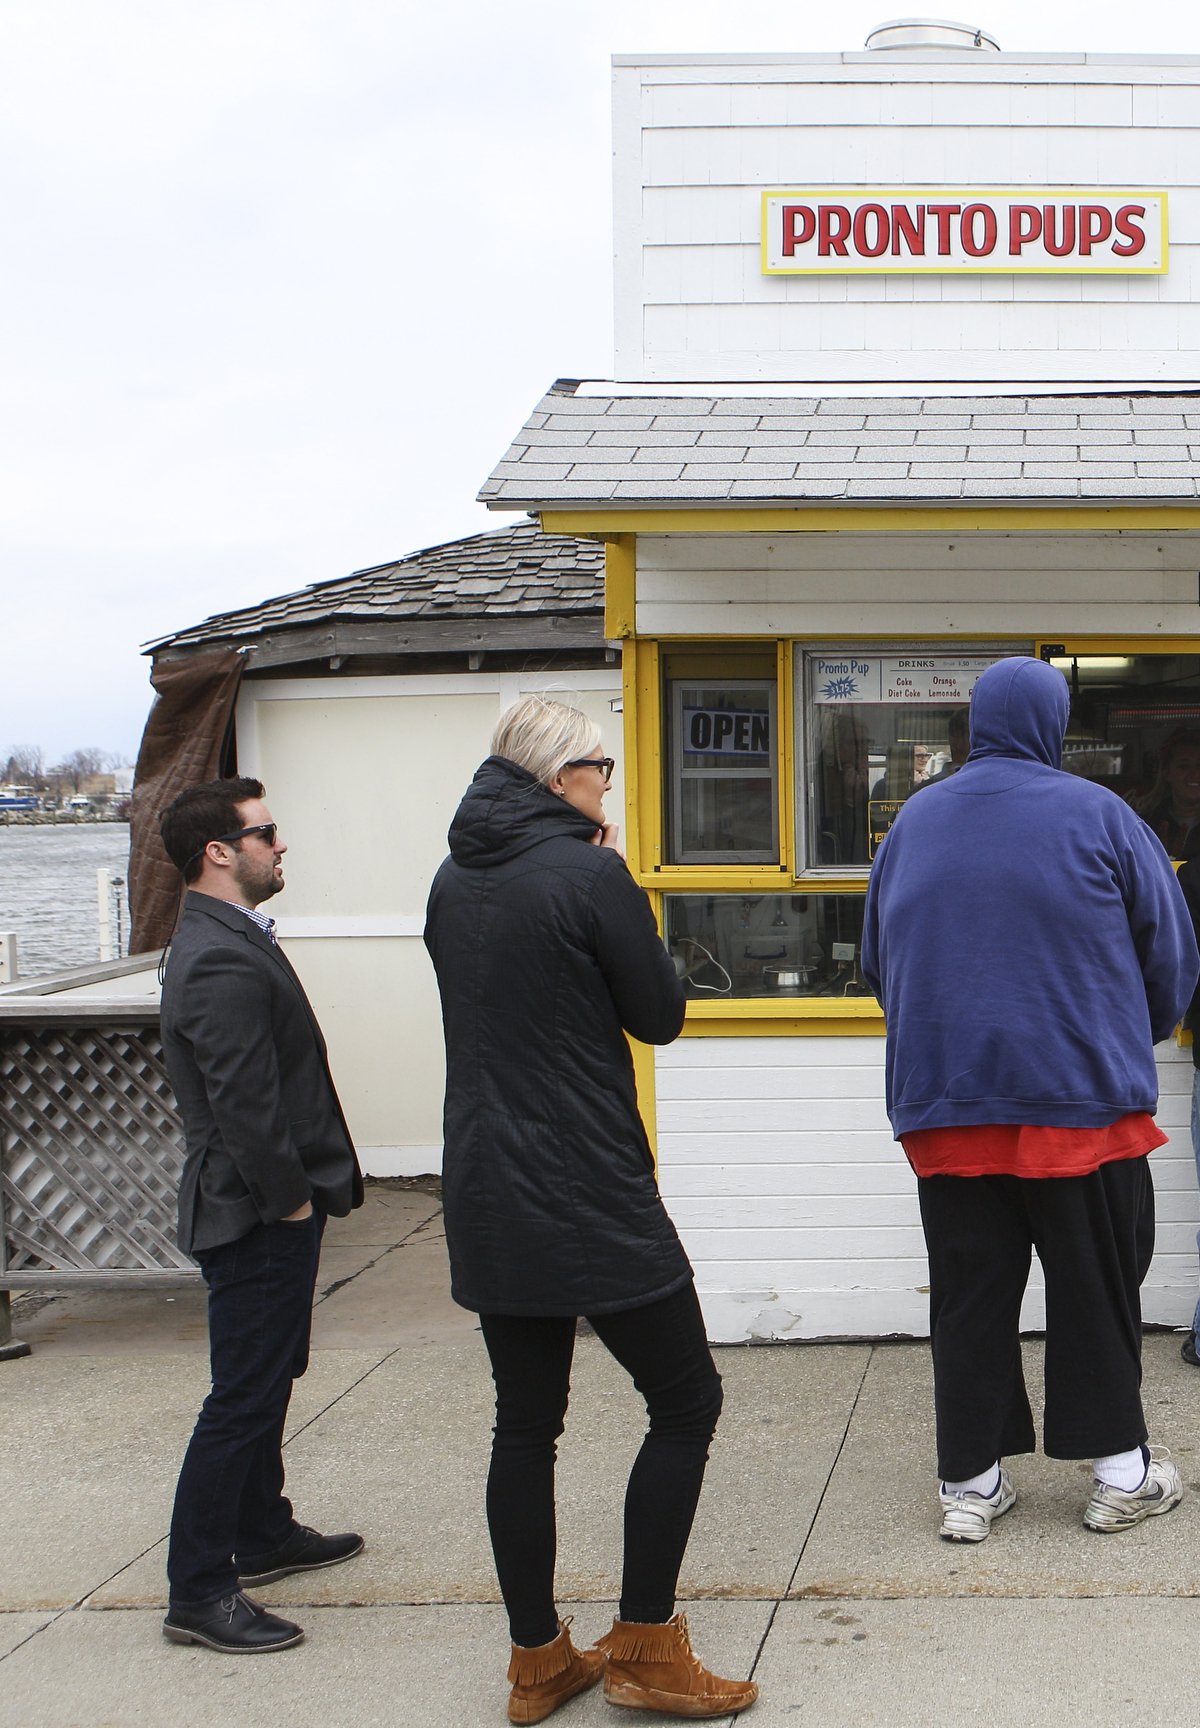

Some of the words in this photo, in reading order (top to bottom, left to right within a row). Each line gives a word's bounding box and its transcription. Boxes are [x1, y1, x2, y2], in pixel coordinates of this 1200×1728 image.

[781, 203, 997, 257] PRONTO
[1008, 203, 1147, 257] PUPS
[818, 660, 849, 674] Pronto
[850, 660, 870, 677] Pup
[898, 660, 935, 668] DRINKS
[896, 677, 913, 686] Coke
[888, 689, 903, 698] Diet
[904, 689, 921, 698] Coke
[928, 688, 961, 698] Lemonade
[690, 711, 769, 753] OPEN
